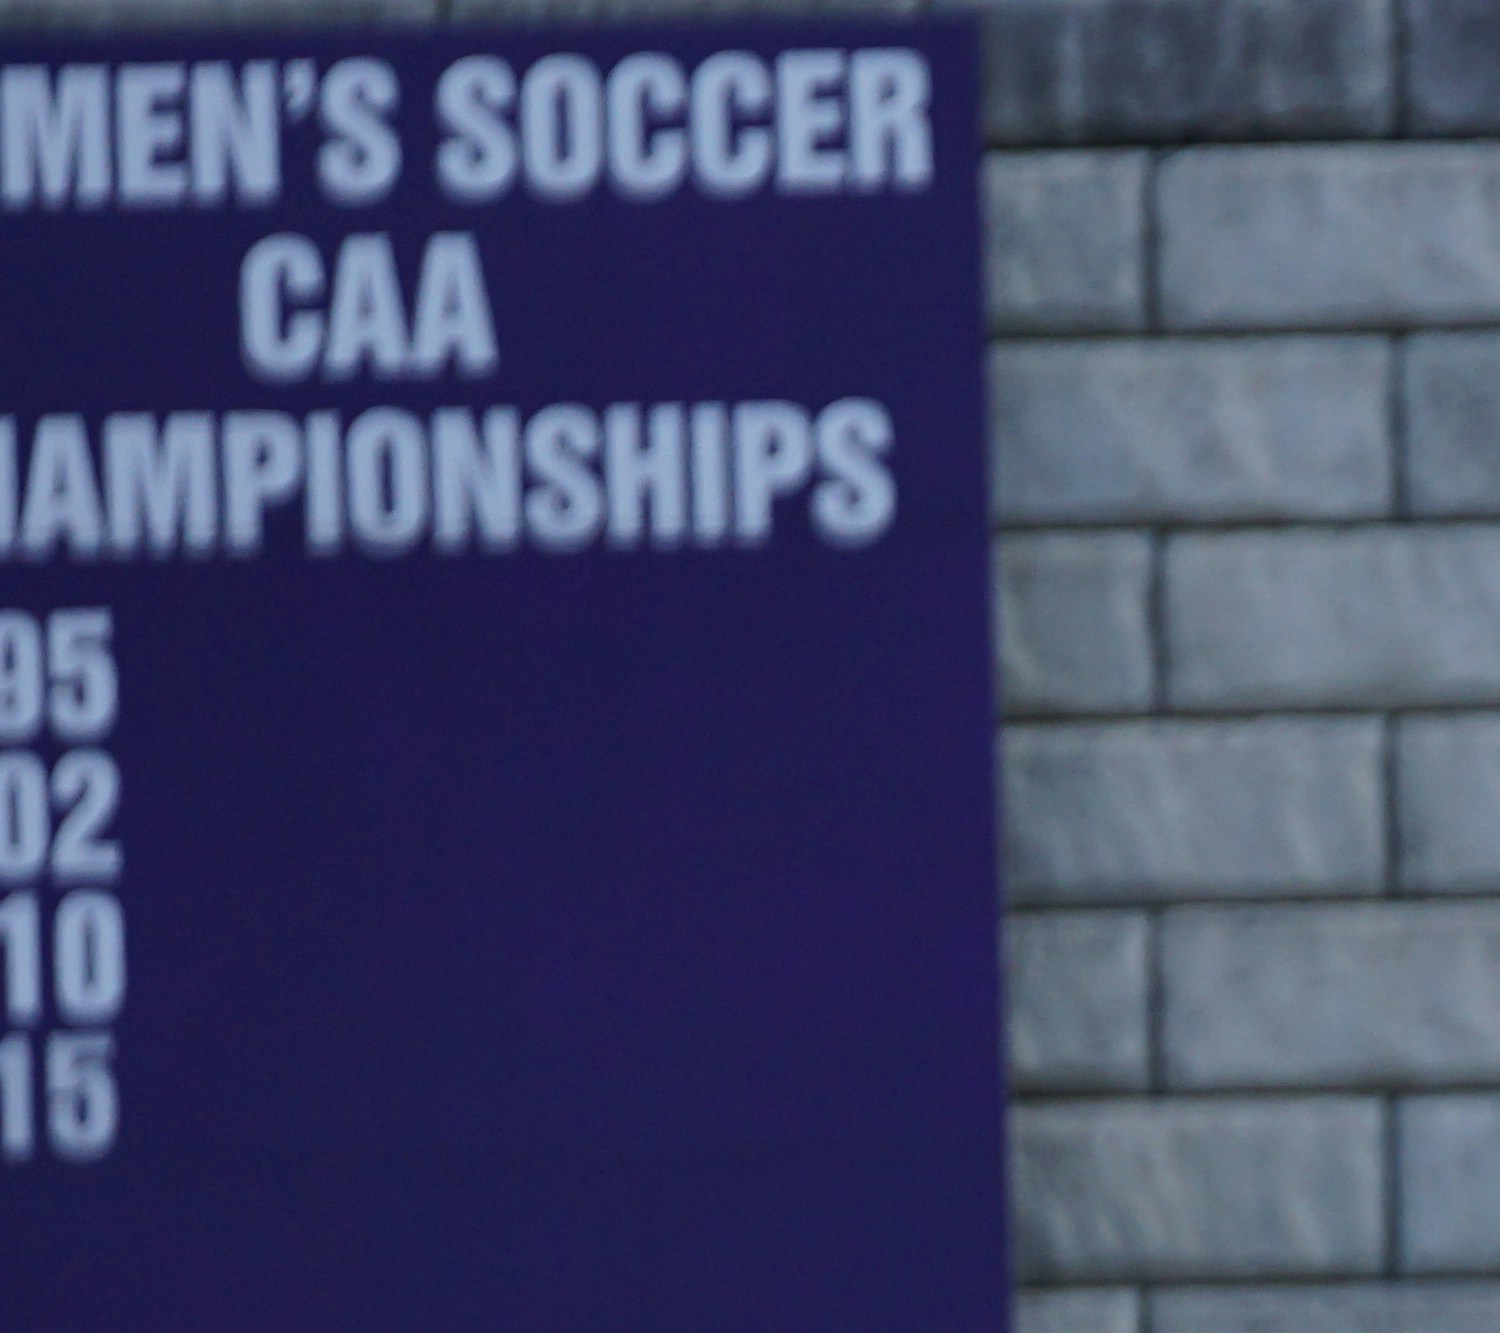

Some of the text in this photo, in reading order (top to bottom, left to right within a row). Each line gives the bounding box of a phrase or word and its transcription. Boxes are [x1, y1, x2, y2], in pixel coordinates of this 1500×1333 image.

[437, 50, 931, 198] SOCCER
[241, 234, 496, 377] CAA
[0, 399, 894, 553] AMPIONSHIPS
